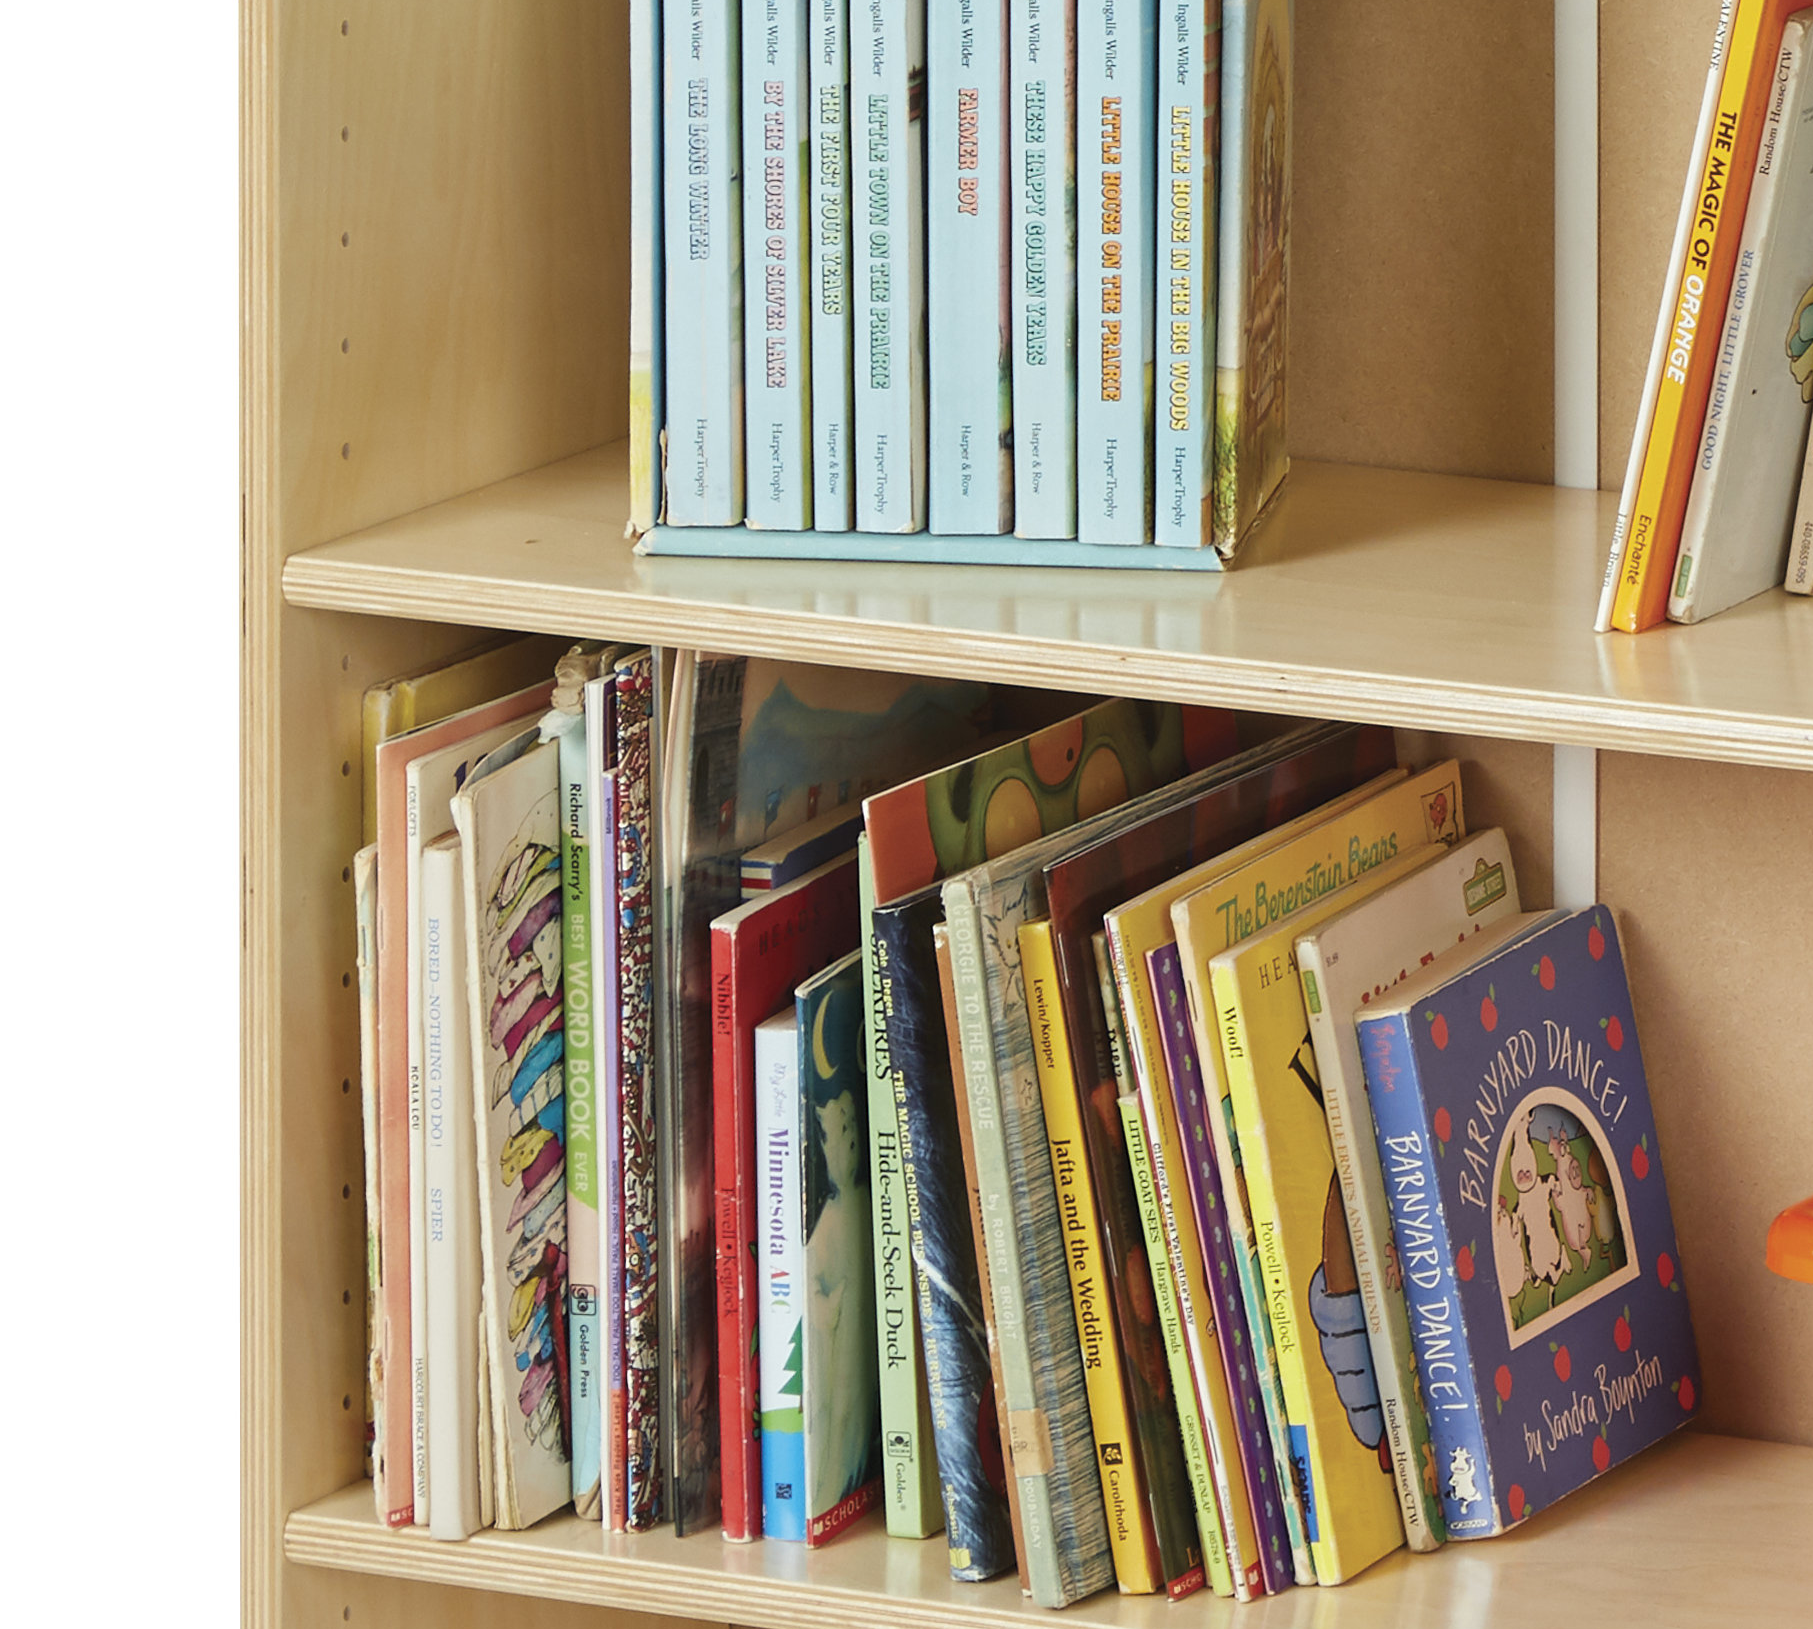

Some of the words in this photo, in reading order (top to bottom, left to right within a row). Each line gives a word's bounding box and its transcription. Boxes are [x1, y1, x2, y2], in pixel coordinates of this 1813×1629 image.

[958, 88, 980, 170] FARMER
[1101, 96, 1122, 164] LITTLE
[958, 176, 979, 215] BOY
[1101, 171, 1122, 234] HOUSE
[1102, 240, 1122, 269] ON
[1101, 275, 1122, 313] THE
[1101, 320, 1122, 402] PRAIRIE
[569, 783, 581, 838] Richard
[569, 844, 583, 901] Scarry's
[571, 914, 585, 952] BEST
[567, 959, 589, 1049] WORD
[1032, 978, 1055, 1069] Lewin/Kopper
[1224, 1007, 1244, 1058] Woof!
[569, 1060, 591, 1141] BOOK
[1459, 1030, 1538, 1209] BARNYARD
[1544, 1020, 1627, 1131] DANCE!
[574, 1151, 588, 1193] EVER
[769, 1128, 788, 1256] Minnesota
[1051, 1139, 1075, 1186] Jafta
[878, 1131, 902, 1300] Hide-and-Seek
[1063, 1194, 1086, 1230] and
[1071, 1239, 1089, 1270] the
[1386, 1131, 1443, 1290] BARNYARD
[1417, 1297, 1467, 1422] DANCE!
[885, 1308, 906, 1370] Duck
[1077, 1278, 1102, 1369] Wedding
[1524, 1423, 1546, 1471] by
[1544, 1391, 1597, 1449] Sandra
[1596, 1351, 1663, 1426] Boynton
[1109, 1470, 1128, 1541] Carolrhoda
